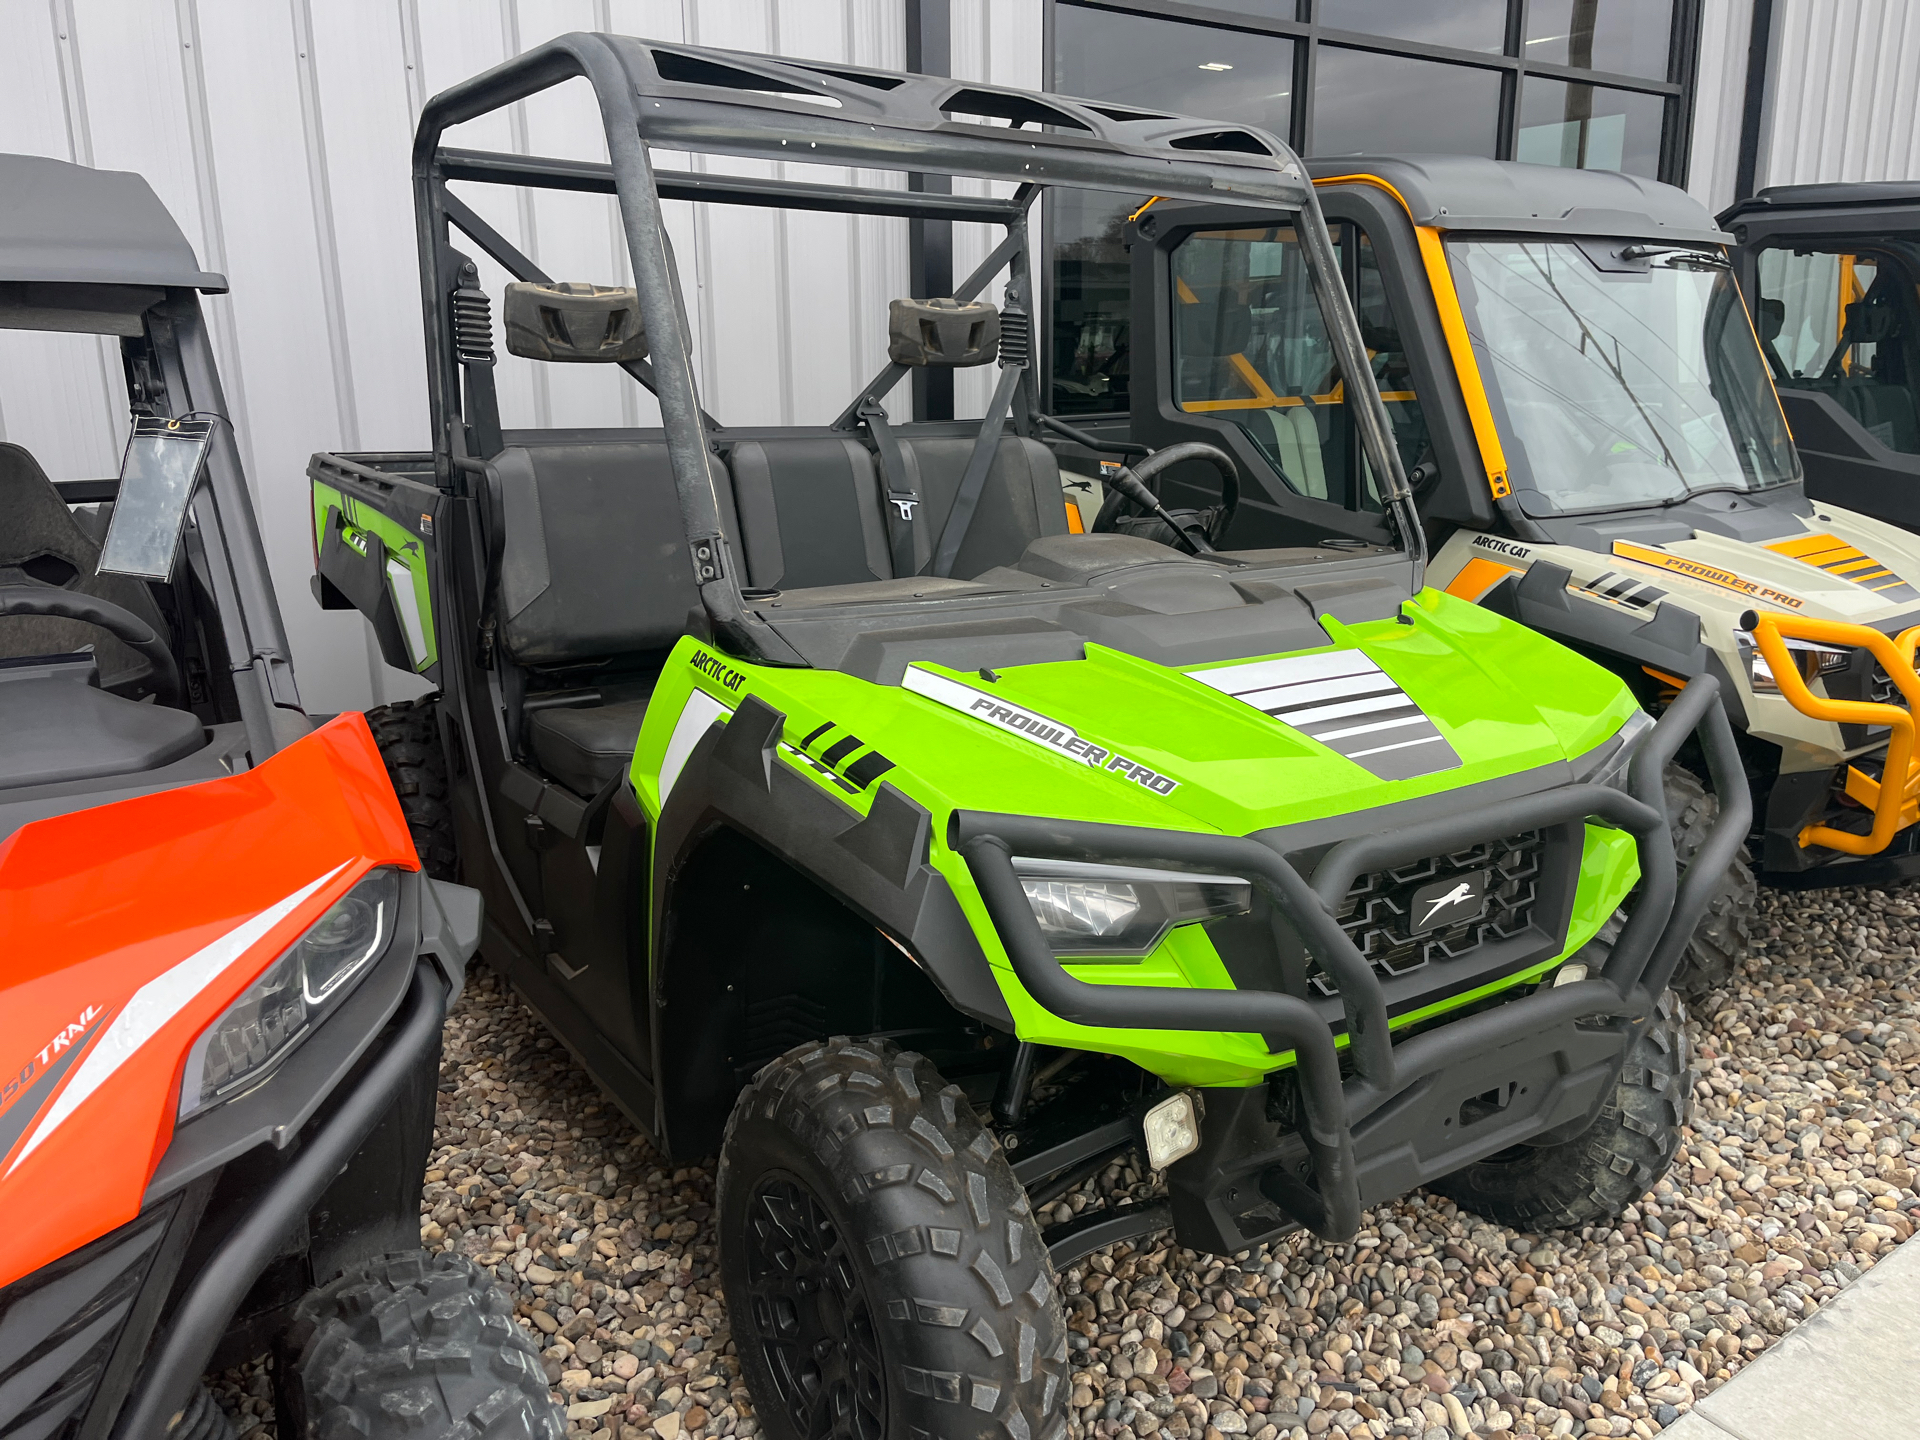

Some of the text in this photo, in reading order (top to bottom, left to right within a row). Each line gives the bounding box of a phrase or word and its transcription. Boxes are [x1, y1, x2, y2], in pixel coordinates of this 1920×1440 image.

[1472, 536, 1531, 559] ARCTIC CAT
[1665, 558, 1804, 609] PROWLER PRO
[689, 649, 747, 692] ARCTIC CAT
[969, 697, 1178, 796] PROWLER PRO
[0, 1004, 104, 1106] 50 TRAIL
